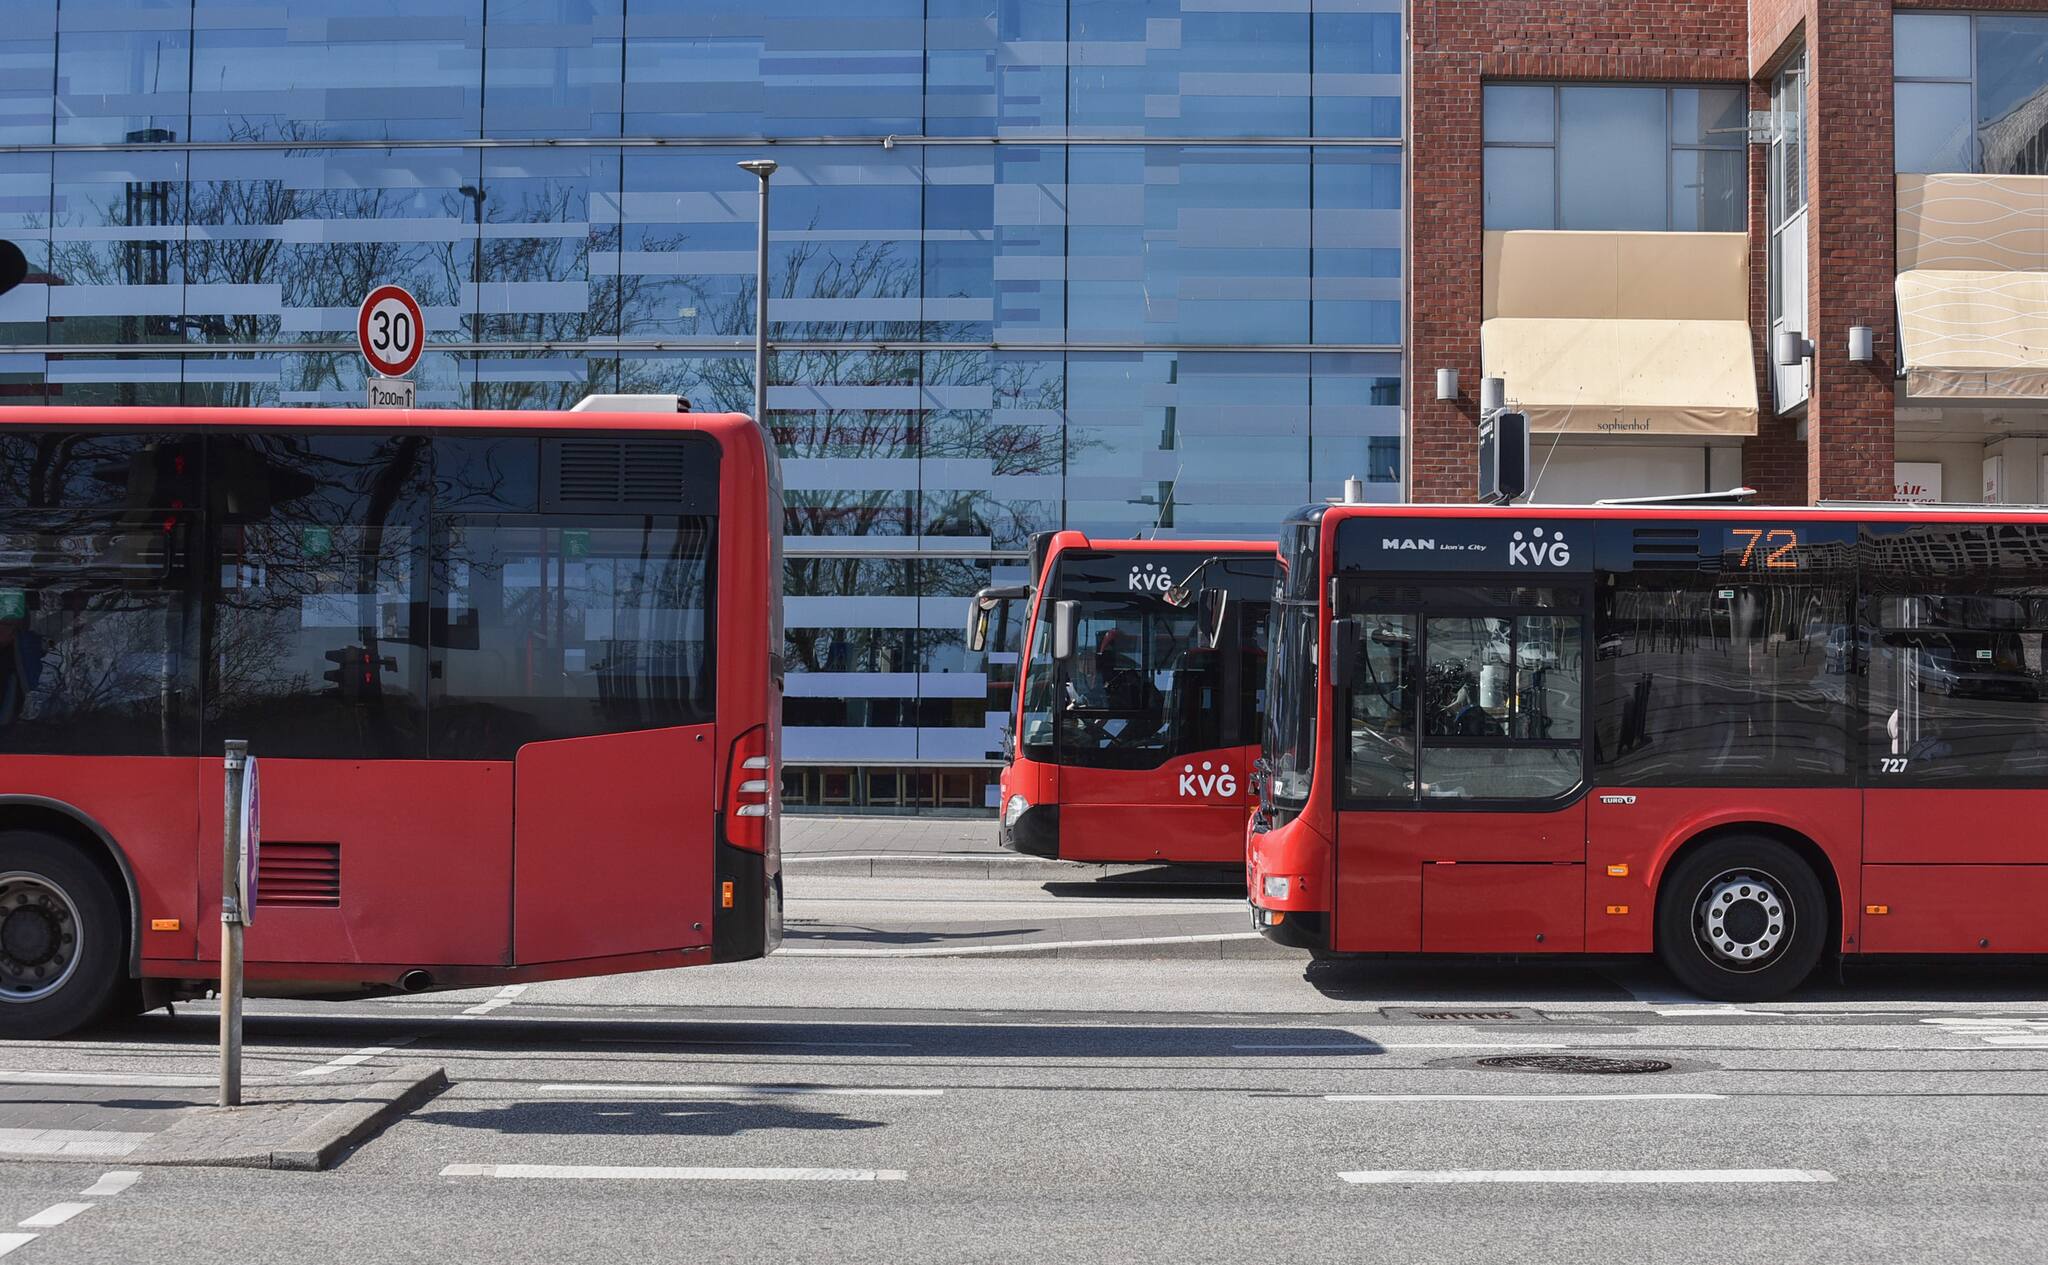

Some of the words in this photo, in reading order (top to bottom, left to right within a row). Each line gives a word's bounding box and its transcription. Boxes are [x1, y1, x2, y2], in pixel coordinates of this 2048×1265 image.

[373, 311, 410, 352] 30
[379, 392, 404, 405] 200m
[1597, 417, 1651, 435] sophienhof
[1382, 538, 1435, 550] MAN
[1440, 543, 1465, 551] Lion's
[1732, 529, 1797, 567] 72
[1509, 541, 1570, 567] KVG
[1128, 573, 1171, 591] KVG
[1881, 758, 1908, 773] 727
[1179, 774, 1237, 797] KVG
